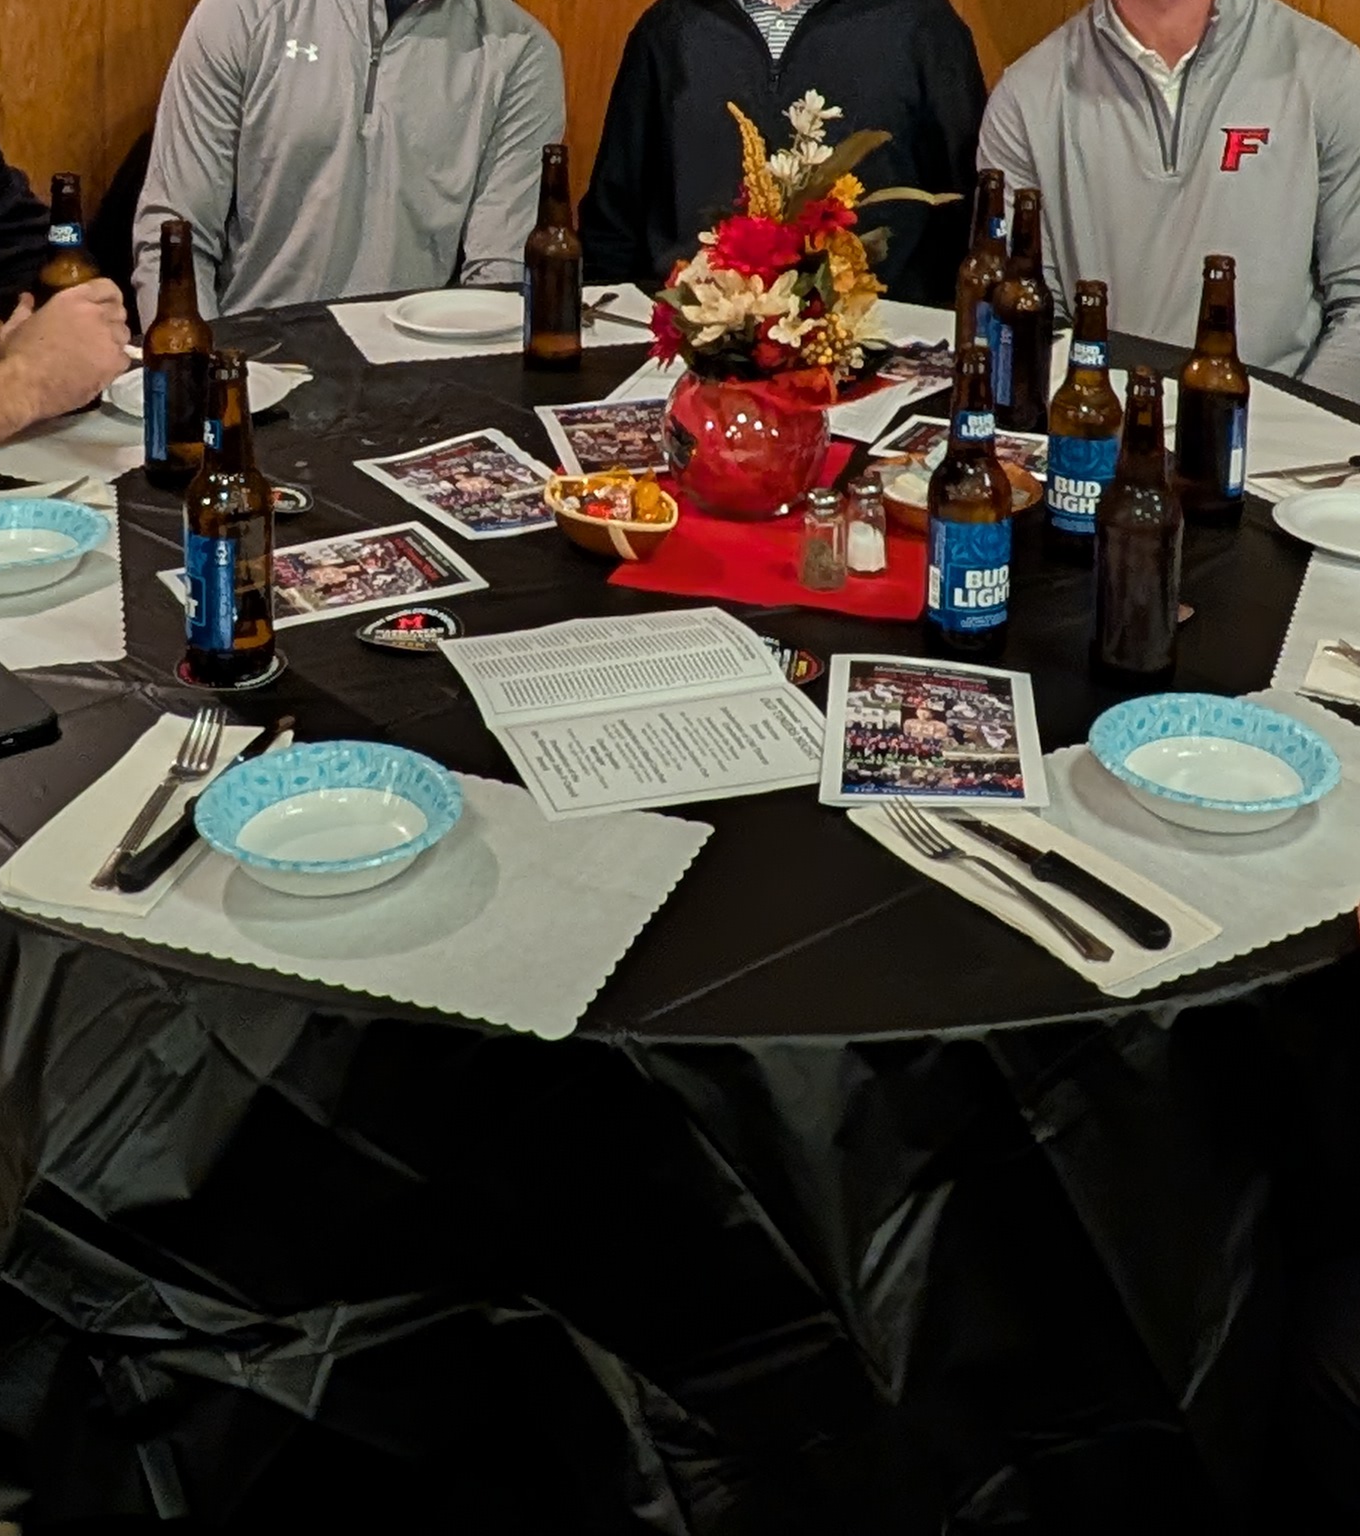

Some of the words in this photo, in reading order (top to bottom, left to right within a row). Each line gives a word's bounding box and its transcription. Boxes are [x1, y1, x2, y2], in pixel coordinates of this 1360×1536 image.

[1218, 124, 1272, 174] F
[961, 424, 996, 438] LIGH
[1054, 475, 1102, 499] BUD
[1048, 488, 1102, 515] LIGH
[965, 565, 1010, 590] BUD
